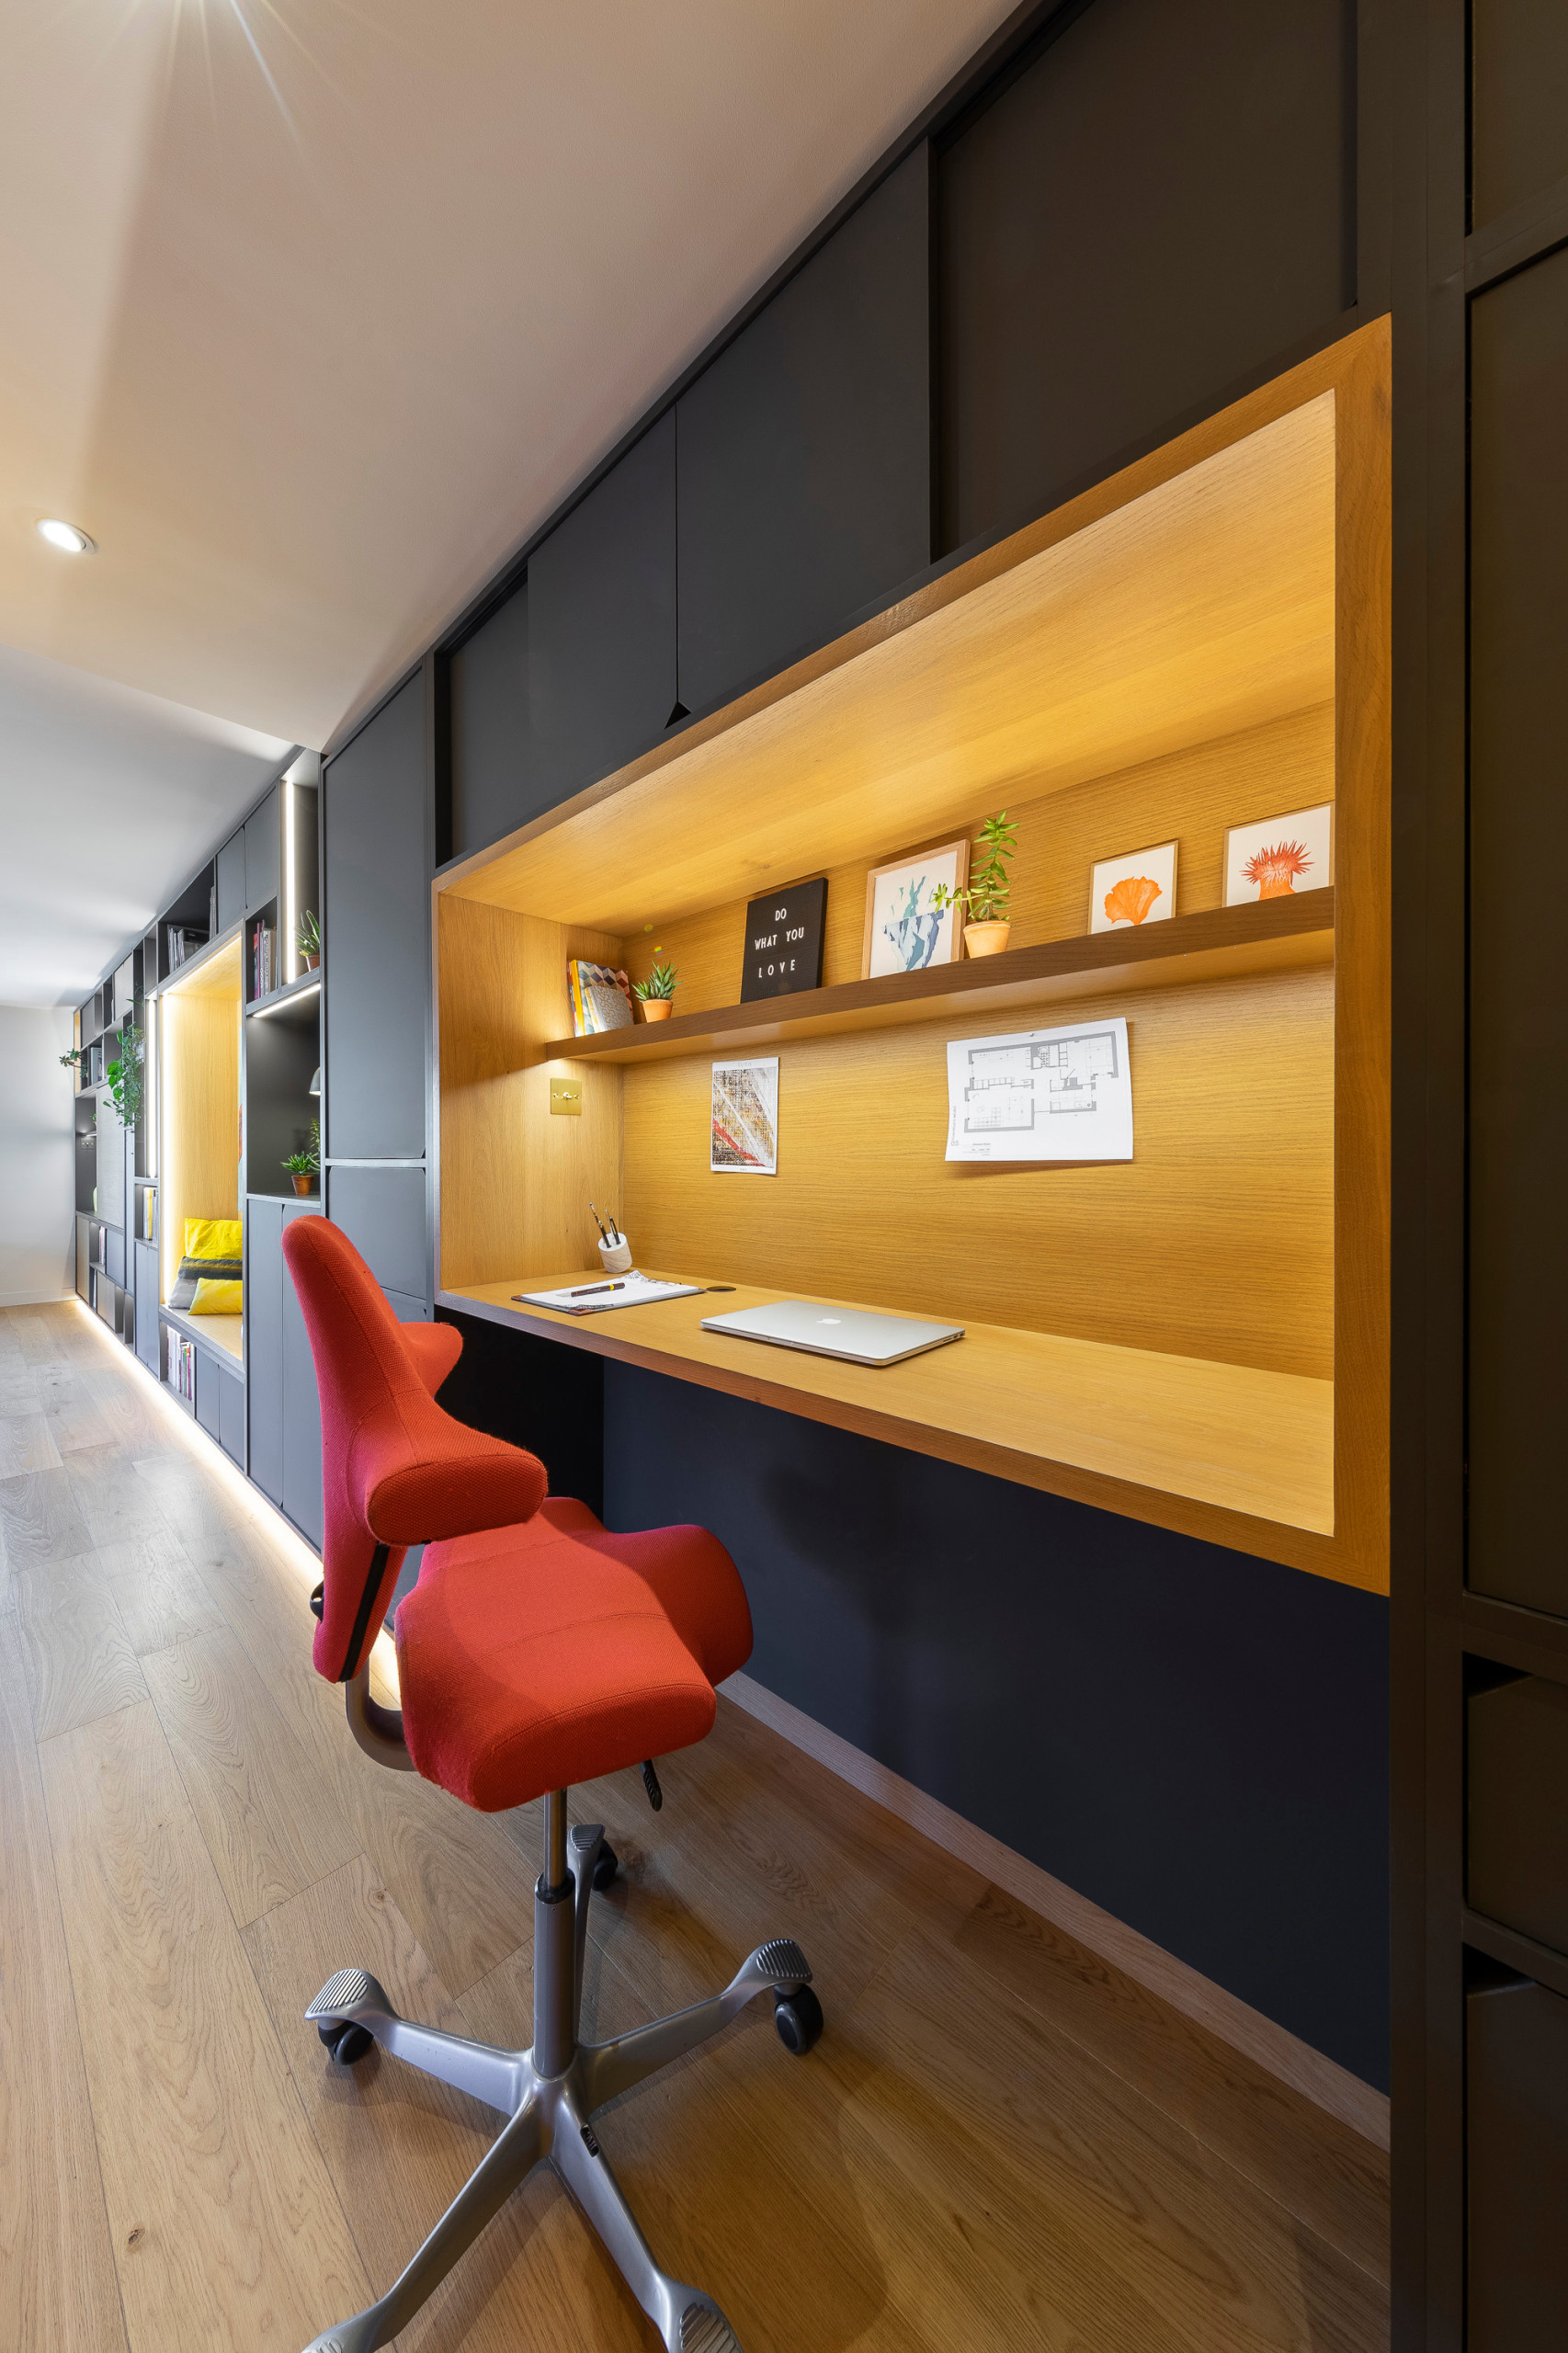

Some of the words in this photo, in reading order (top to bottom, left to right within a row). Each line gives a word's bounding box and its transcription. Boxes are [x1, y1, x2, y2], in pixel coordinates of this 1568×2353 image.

[775, 908, 787, 921] DO
[755, 935, 778, 950] WHAT
[786, 926, 804, 942] YOU
[758, 960, 796, 978] LOVE
